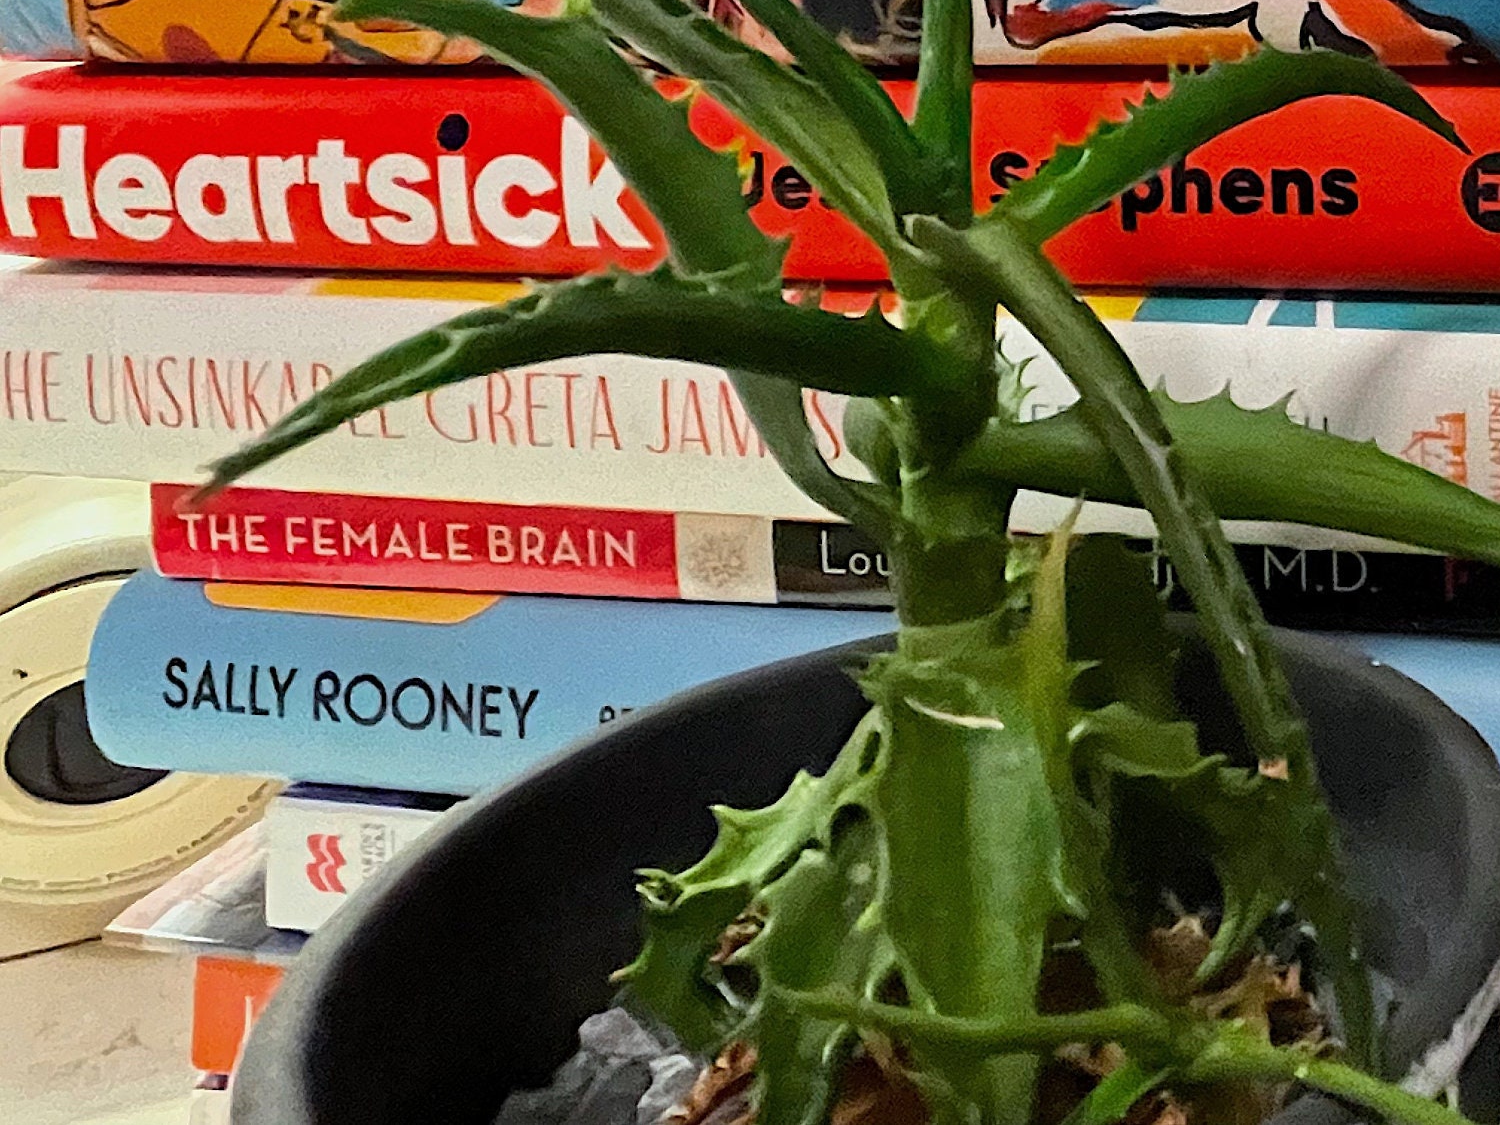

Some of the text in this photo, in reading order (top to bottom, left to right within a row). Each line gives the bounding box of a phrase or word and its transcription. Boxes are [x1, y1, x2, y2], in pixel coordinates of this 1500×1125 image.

[0, 112, 653, 249] Heartsick
[988, 150, 1360, 233] Sphens
[4, 350, 68, 422] HE
[426, 370, 623, 452] GRETA
[646, 375, 841, 461] JAMS
[179, 512, 638, 569] THE FEMALE BRAIN
[1261, 546, 1380, 594] M.D.
[162, 657, 541, 742] SALLY ROONEY
